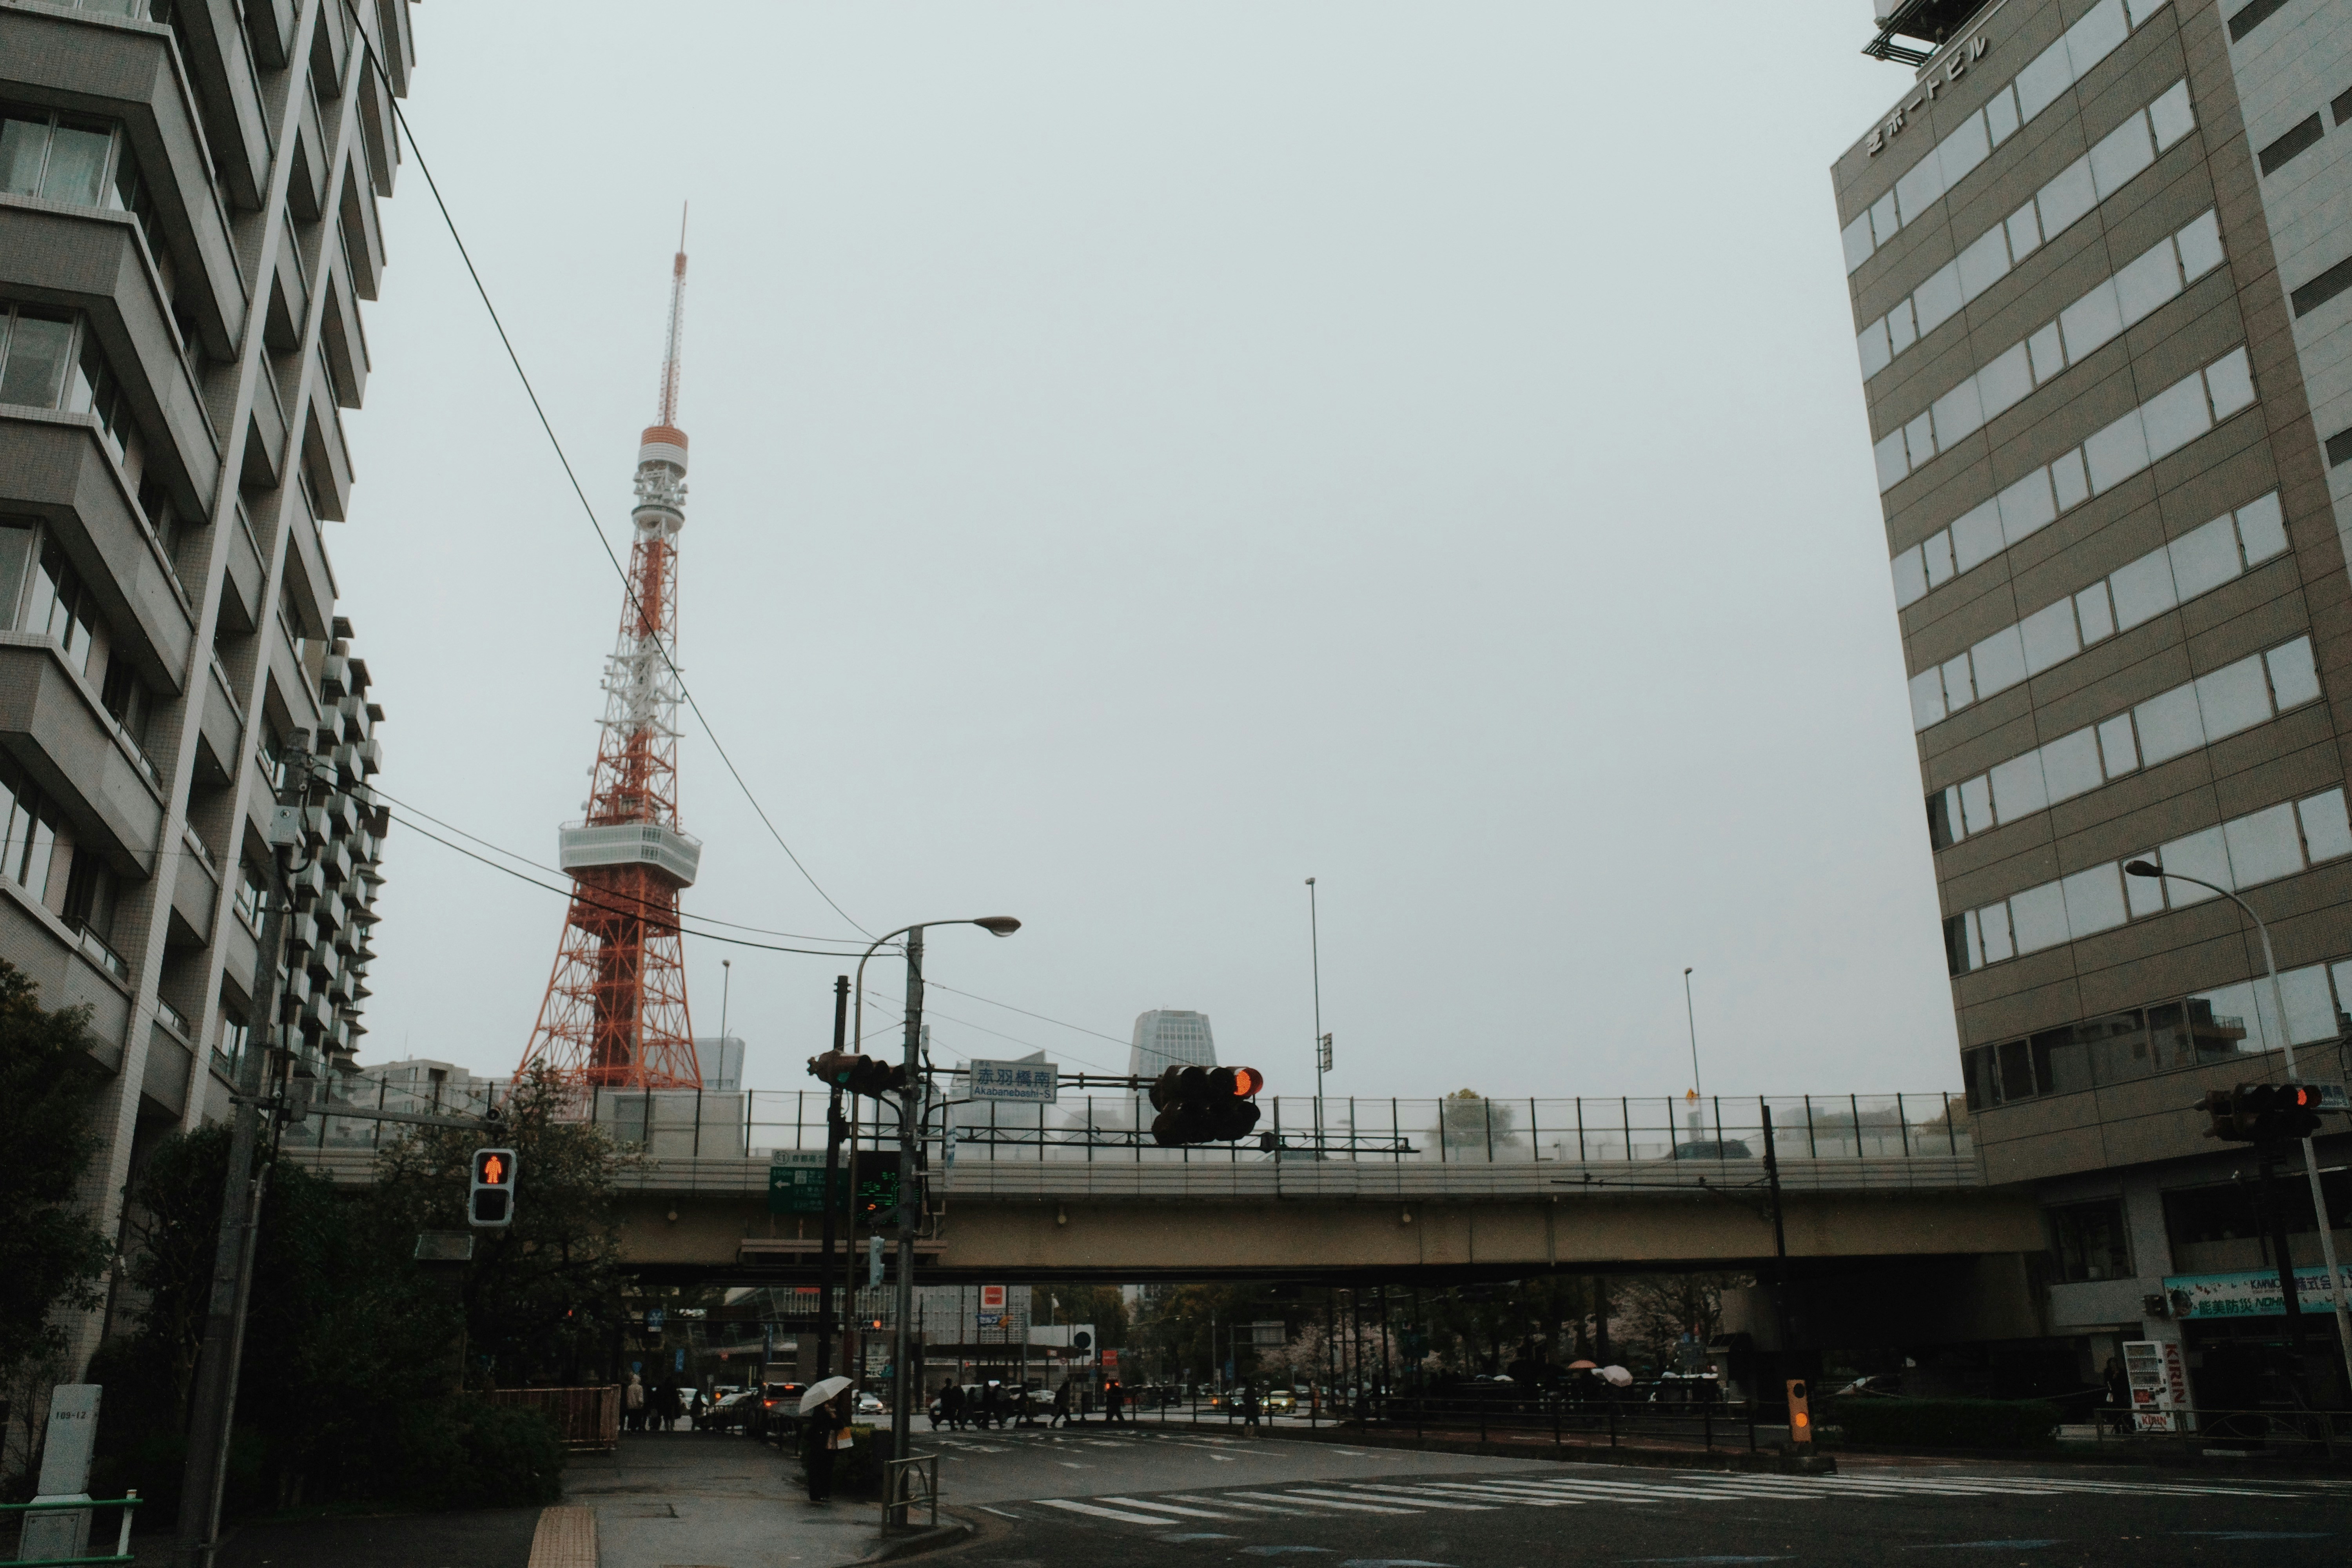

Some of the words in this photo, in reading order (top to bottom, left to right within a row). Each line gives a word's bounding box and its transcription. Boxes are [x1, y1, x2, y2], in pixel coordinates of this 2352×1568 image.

[978, 1068, 1050, 1087] 赤羽橋南
[2199, 1298, 2254, 1315] 能美防災
[2165, 1344, 2186, 1403] KIRIN
[2141, 1415, 2167, 1425] KIRIN
